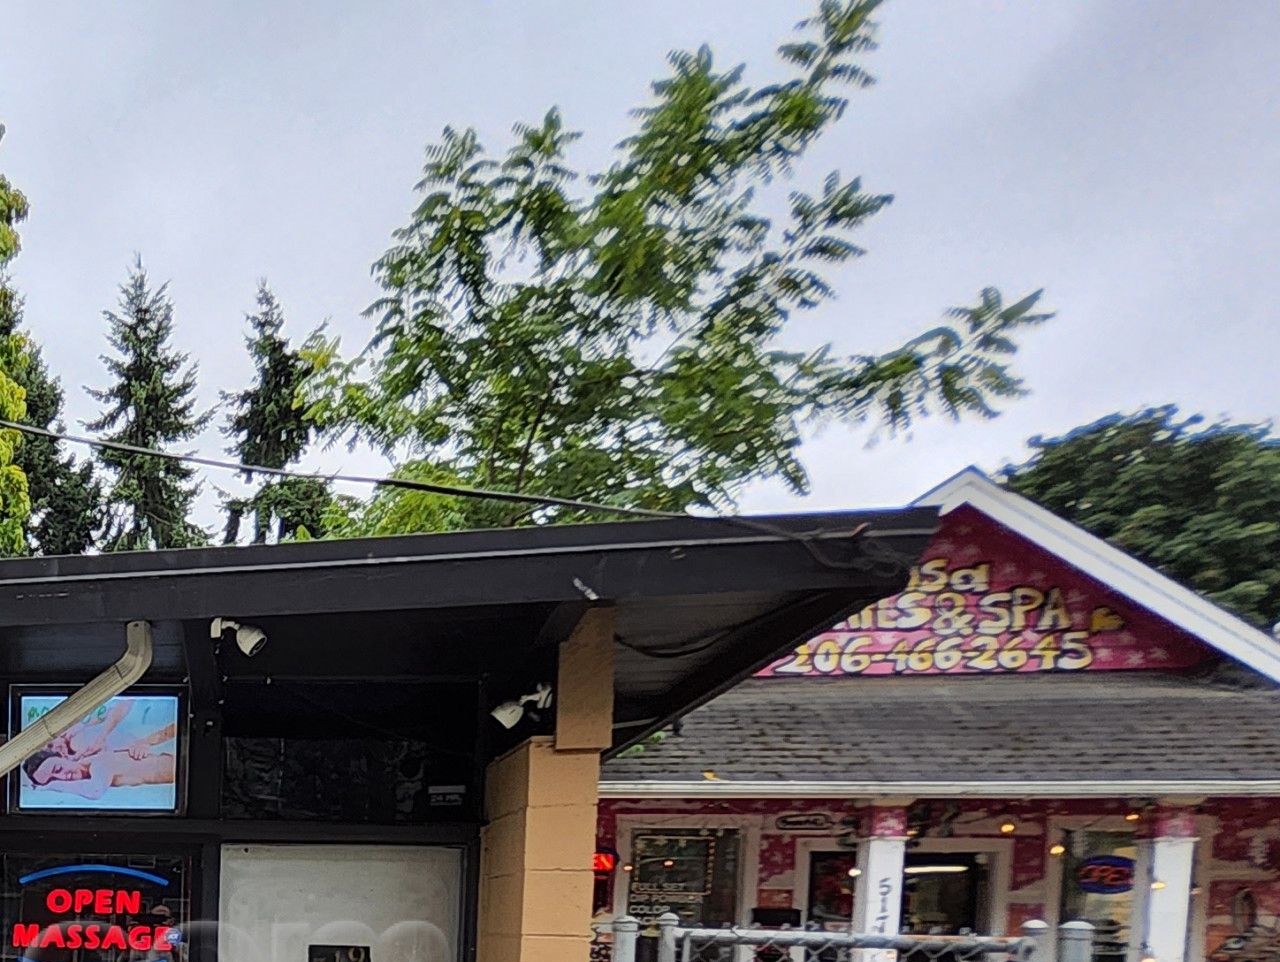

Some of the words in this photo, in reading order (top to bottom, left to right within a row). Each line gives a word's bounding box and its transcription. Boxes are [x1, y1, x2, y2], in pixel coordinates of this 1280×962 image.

[976, 586, 1071, 635] SPA
[46, 889, 141, 914] OPEN
[12, 923, 173, 951] MASSAGE
